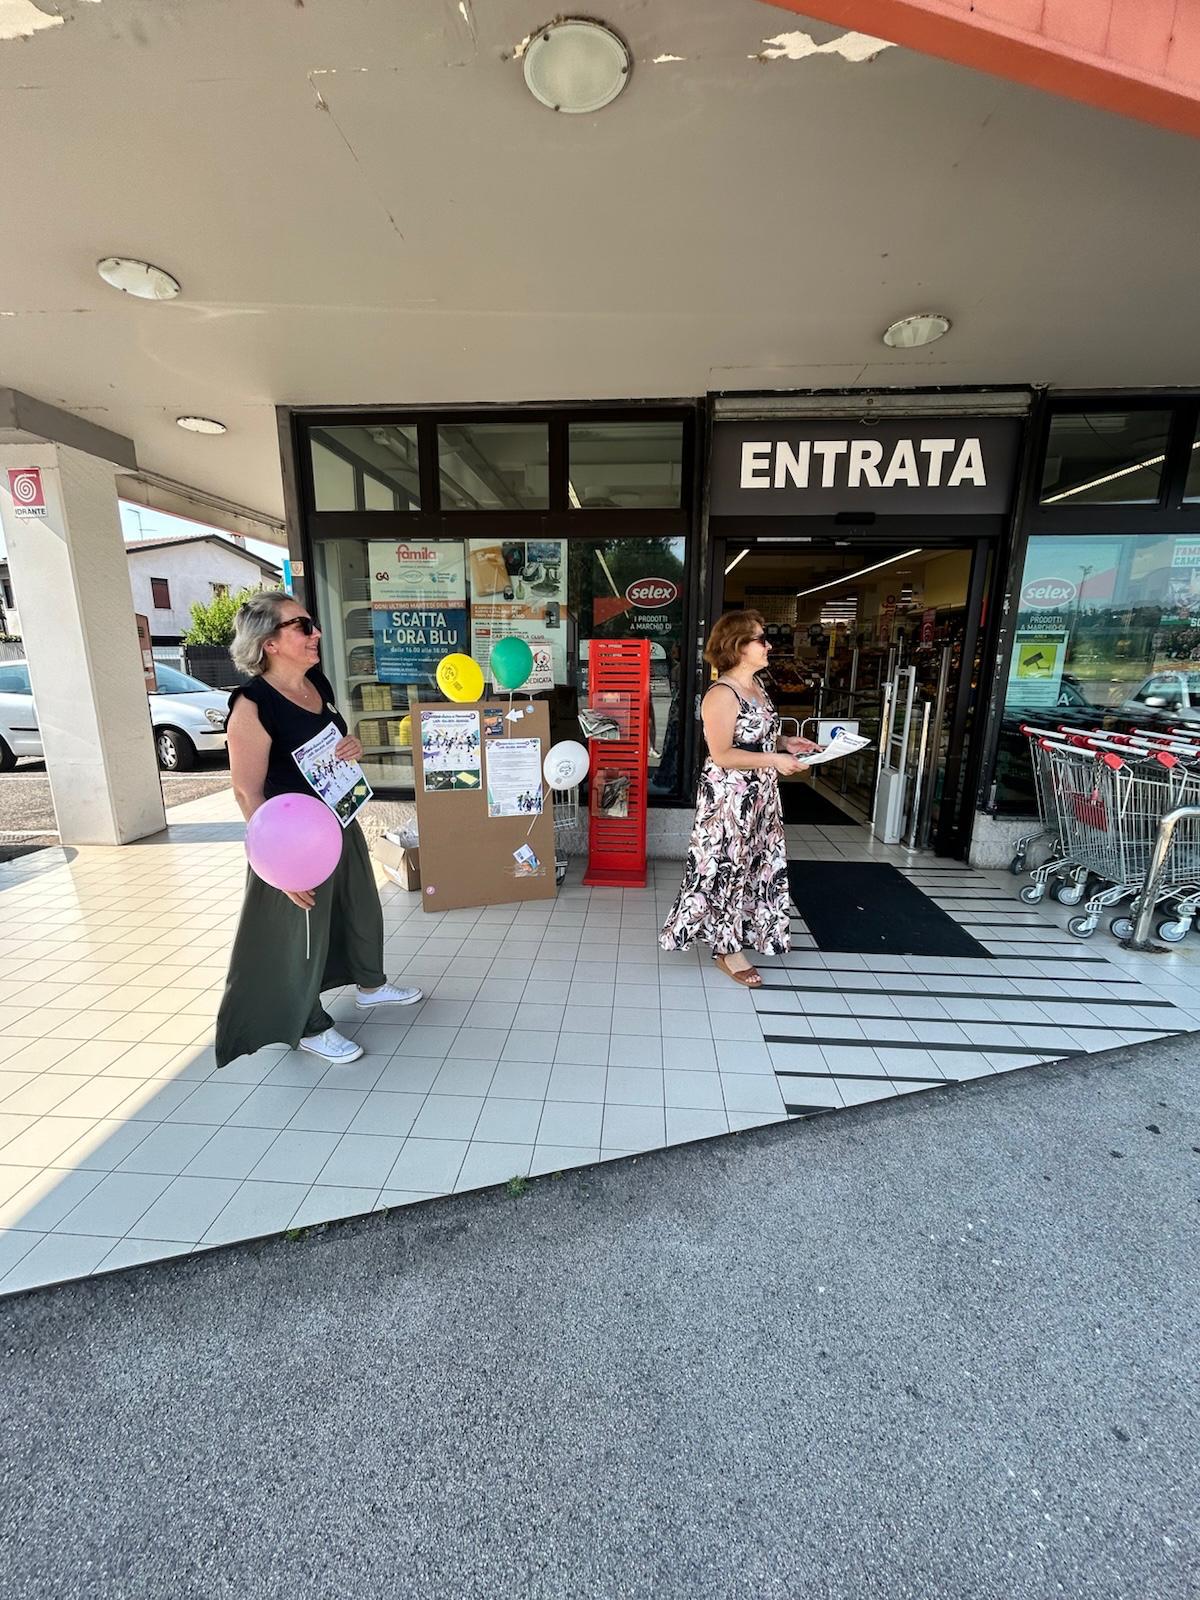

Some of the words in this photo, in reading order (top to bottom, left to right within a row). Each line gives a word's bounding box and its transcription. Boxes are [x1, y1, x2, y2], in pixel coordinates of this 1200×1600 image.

[740, 438, 987, 489] ENTRATA
[395, 544, 437, 562] famila
[631, 585, 673, 599] selex
[1026, 585, 1072, 599] selex
[392, 612, 447, 627] SCATTA
[397, 629, 426, 644] ORA
[430, 629, 457, 645] BLU
